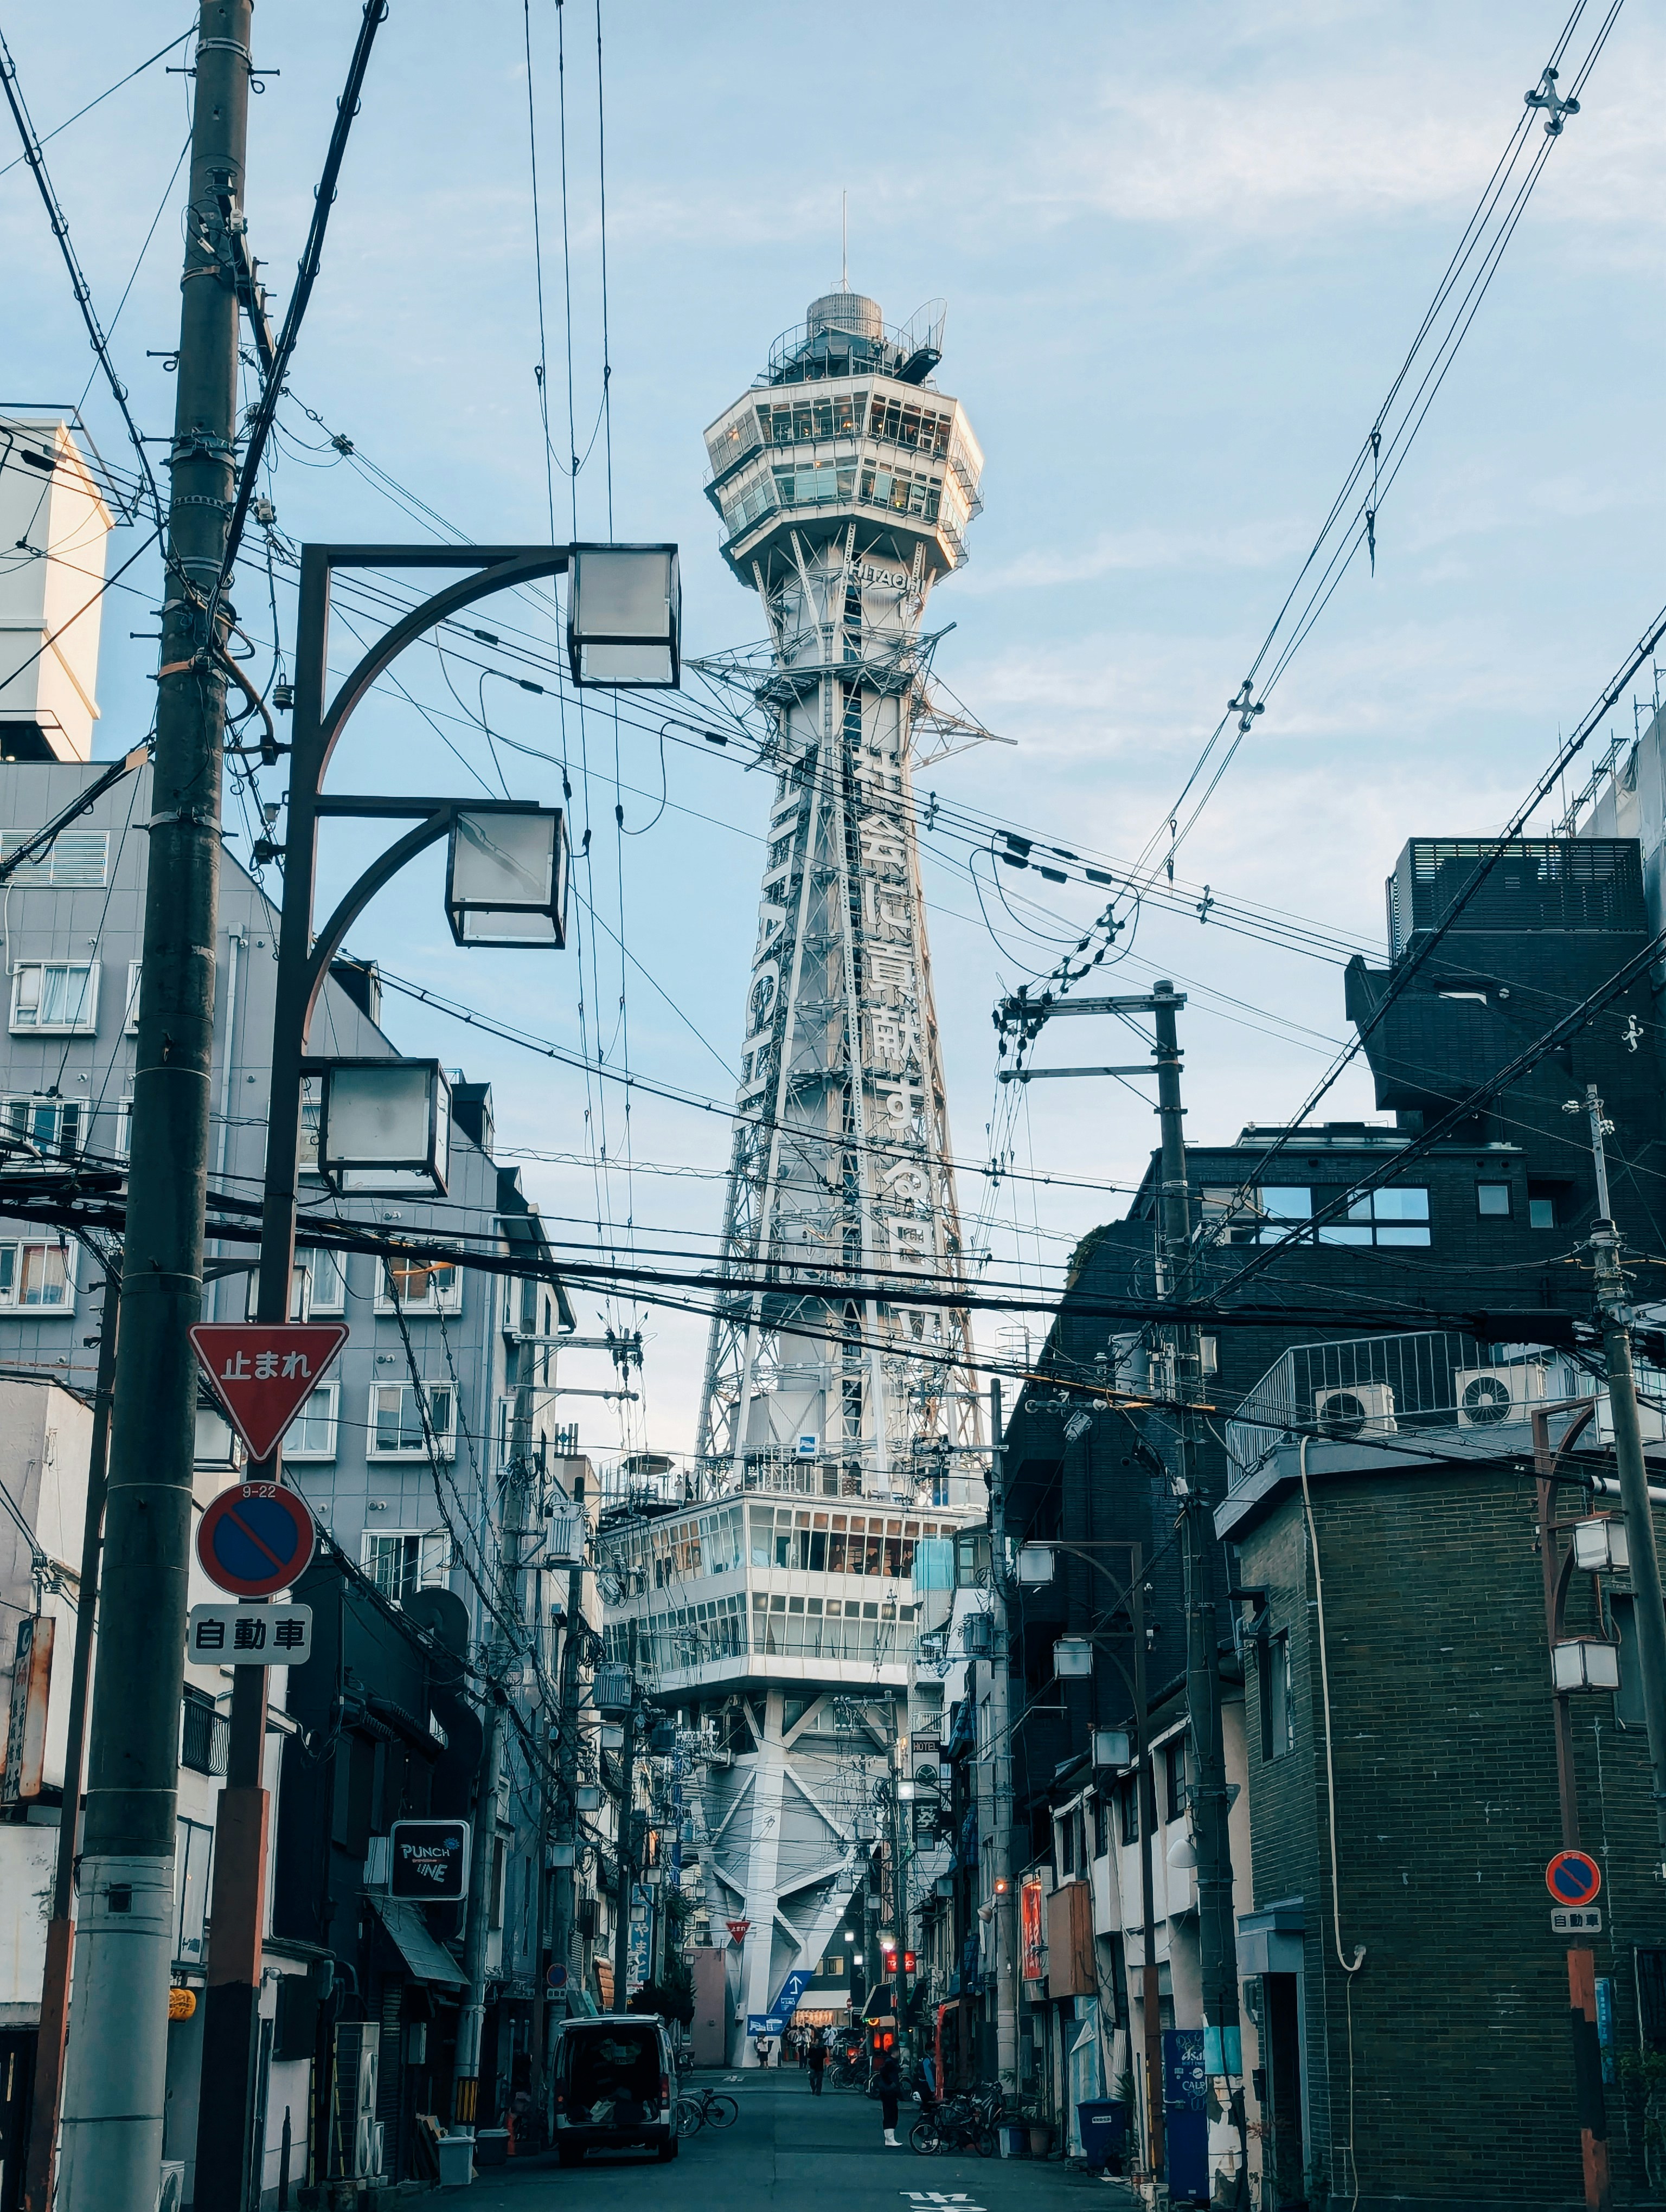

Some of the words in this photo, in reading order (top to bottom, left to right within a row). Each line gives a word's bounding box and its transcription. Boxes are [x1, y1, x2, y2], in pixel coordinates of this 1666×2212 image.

[849, 561, 926, 594] HITACHI
[732, 745, 806, 1133] HITACHI
[220, 1351, 312, 1380] 止まれ
[242, 1485, 275, 1498] 9-22
[195, 1617, 306, 1650] 自動車
[400, 1844, 450, 1859] PUNCH
[416, 1863, 448, 1882] LINE
[1554, 1913, 1599, 1927] 自動車
